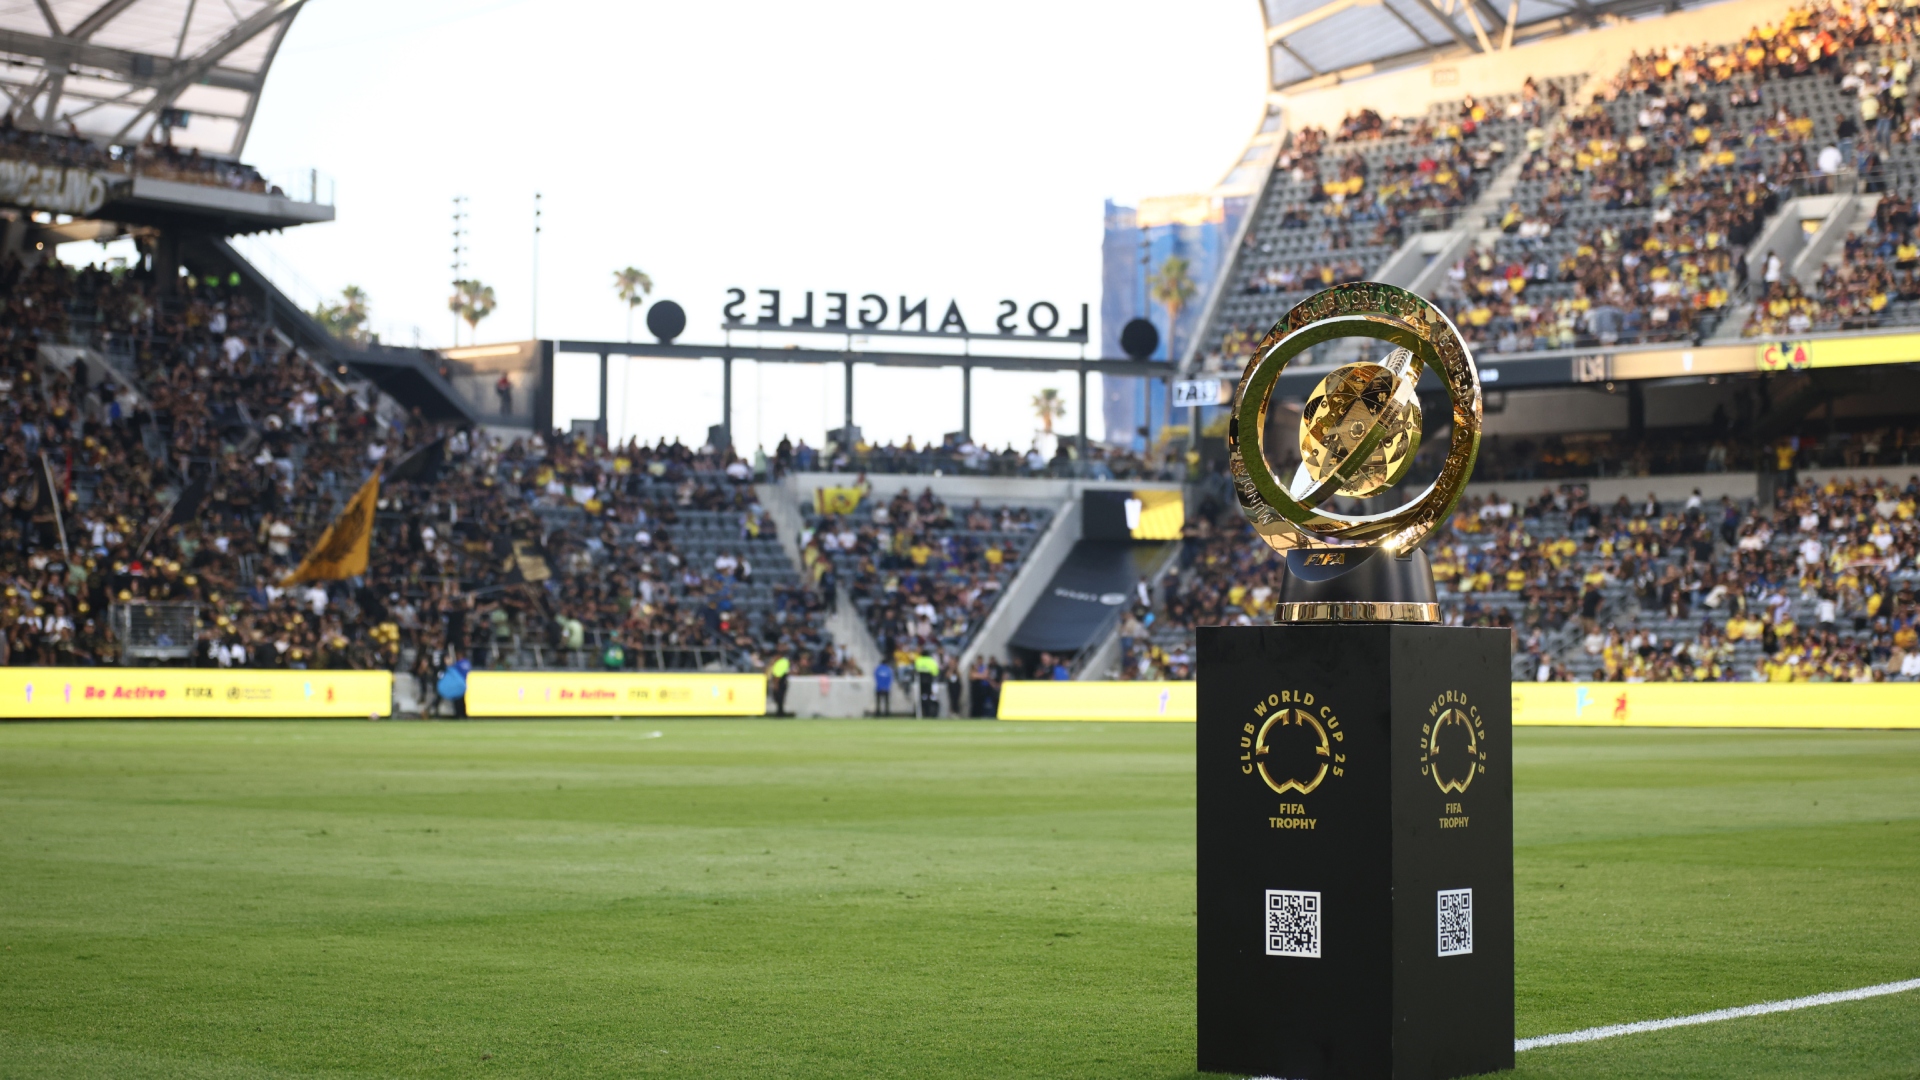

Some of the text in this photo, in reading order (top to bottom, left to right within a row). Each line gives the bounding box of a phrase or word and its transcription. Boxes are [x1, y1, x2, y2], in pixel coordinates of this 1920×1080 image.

[1301, 297, 1335, 321] CLUB
[1336, 290, 1386, 306] WORLD
[1390, 295, 1415, 314] CUP
[1303, 553, 1345, 566] FIFA
[85, 686, 166, 699] Be Active
[1240, 690, 1346, 777] CLUB WORLD CUP 25
[1420, 690, 1487, 776] CLUB WORLD CUP 25
[1280, 803, 1305, 814] FIFA
[1445, 803, 1462, 814] FIFA
[1268, 817, 1317, 829] TROPHY
[1439, 817, 1469, 829] TROPHY
